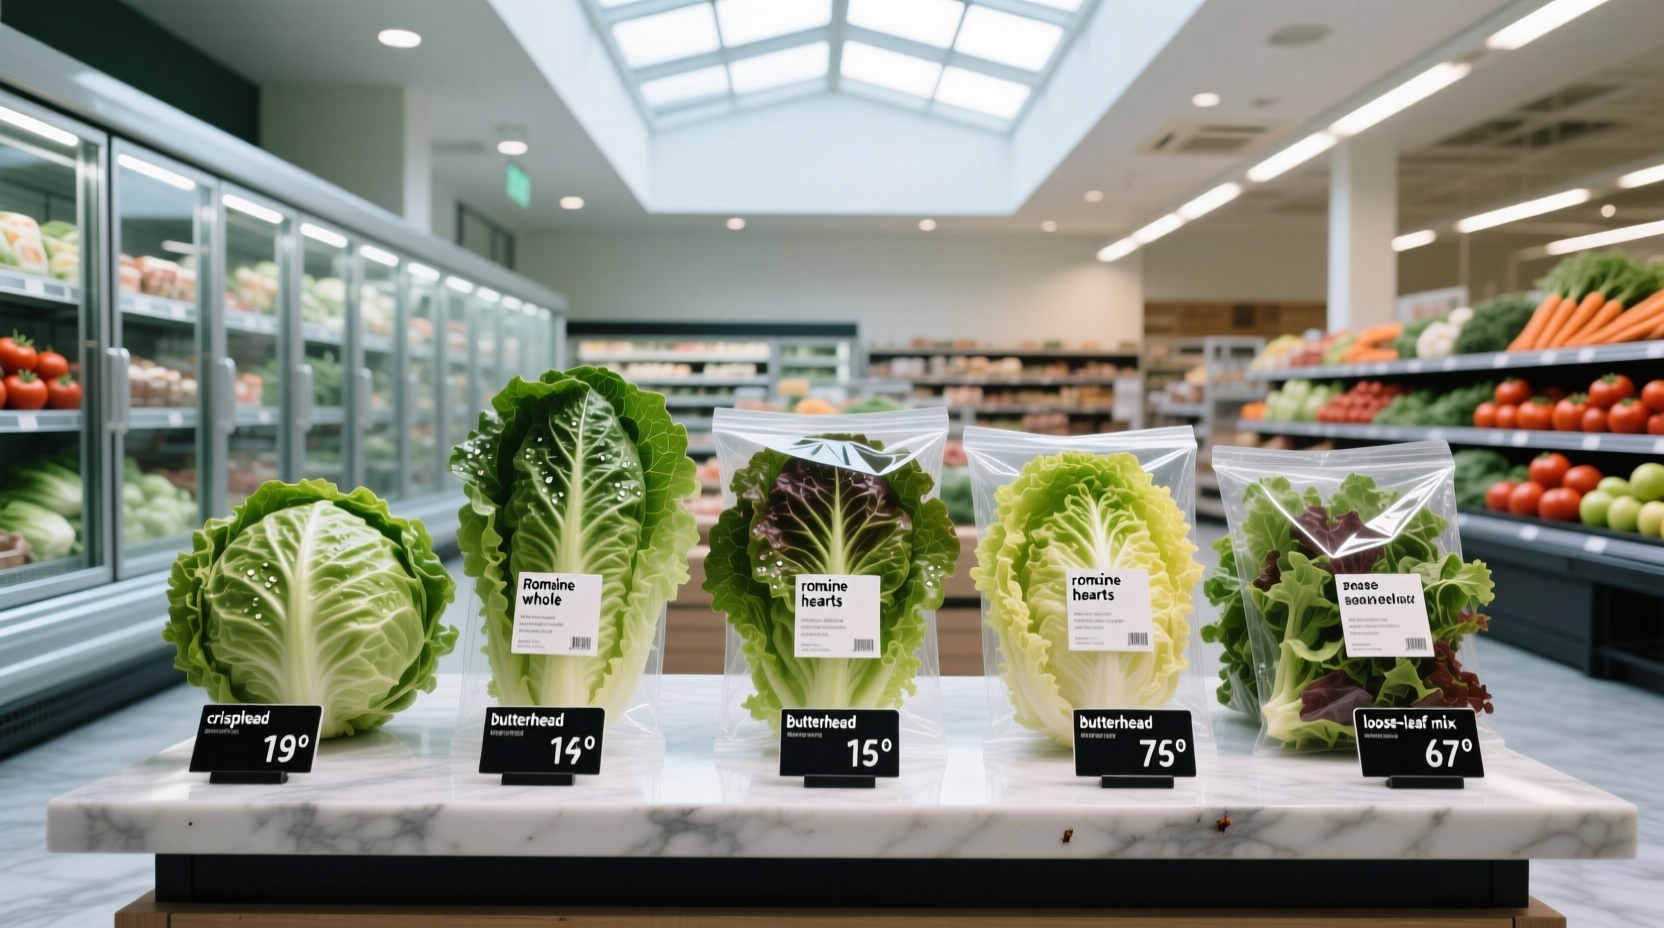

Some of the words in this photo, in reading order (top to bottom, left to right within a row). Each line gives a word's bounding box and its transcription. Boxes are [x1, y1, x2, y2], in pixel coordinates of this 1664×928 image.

[523, 577, 576, 591] Romaine
[522, 591, 562, 606] whole
[801, 593, 843, 608] hearts
[1072, 588, 1115, 601] hearts
[1079, 714, 1153, 729] butterhead
[1363, 713, 1428, 730] loose-leaf
[1431, 714, 1457, 730] mix
